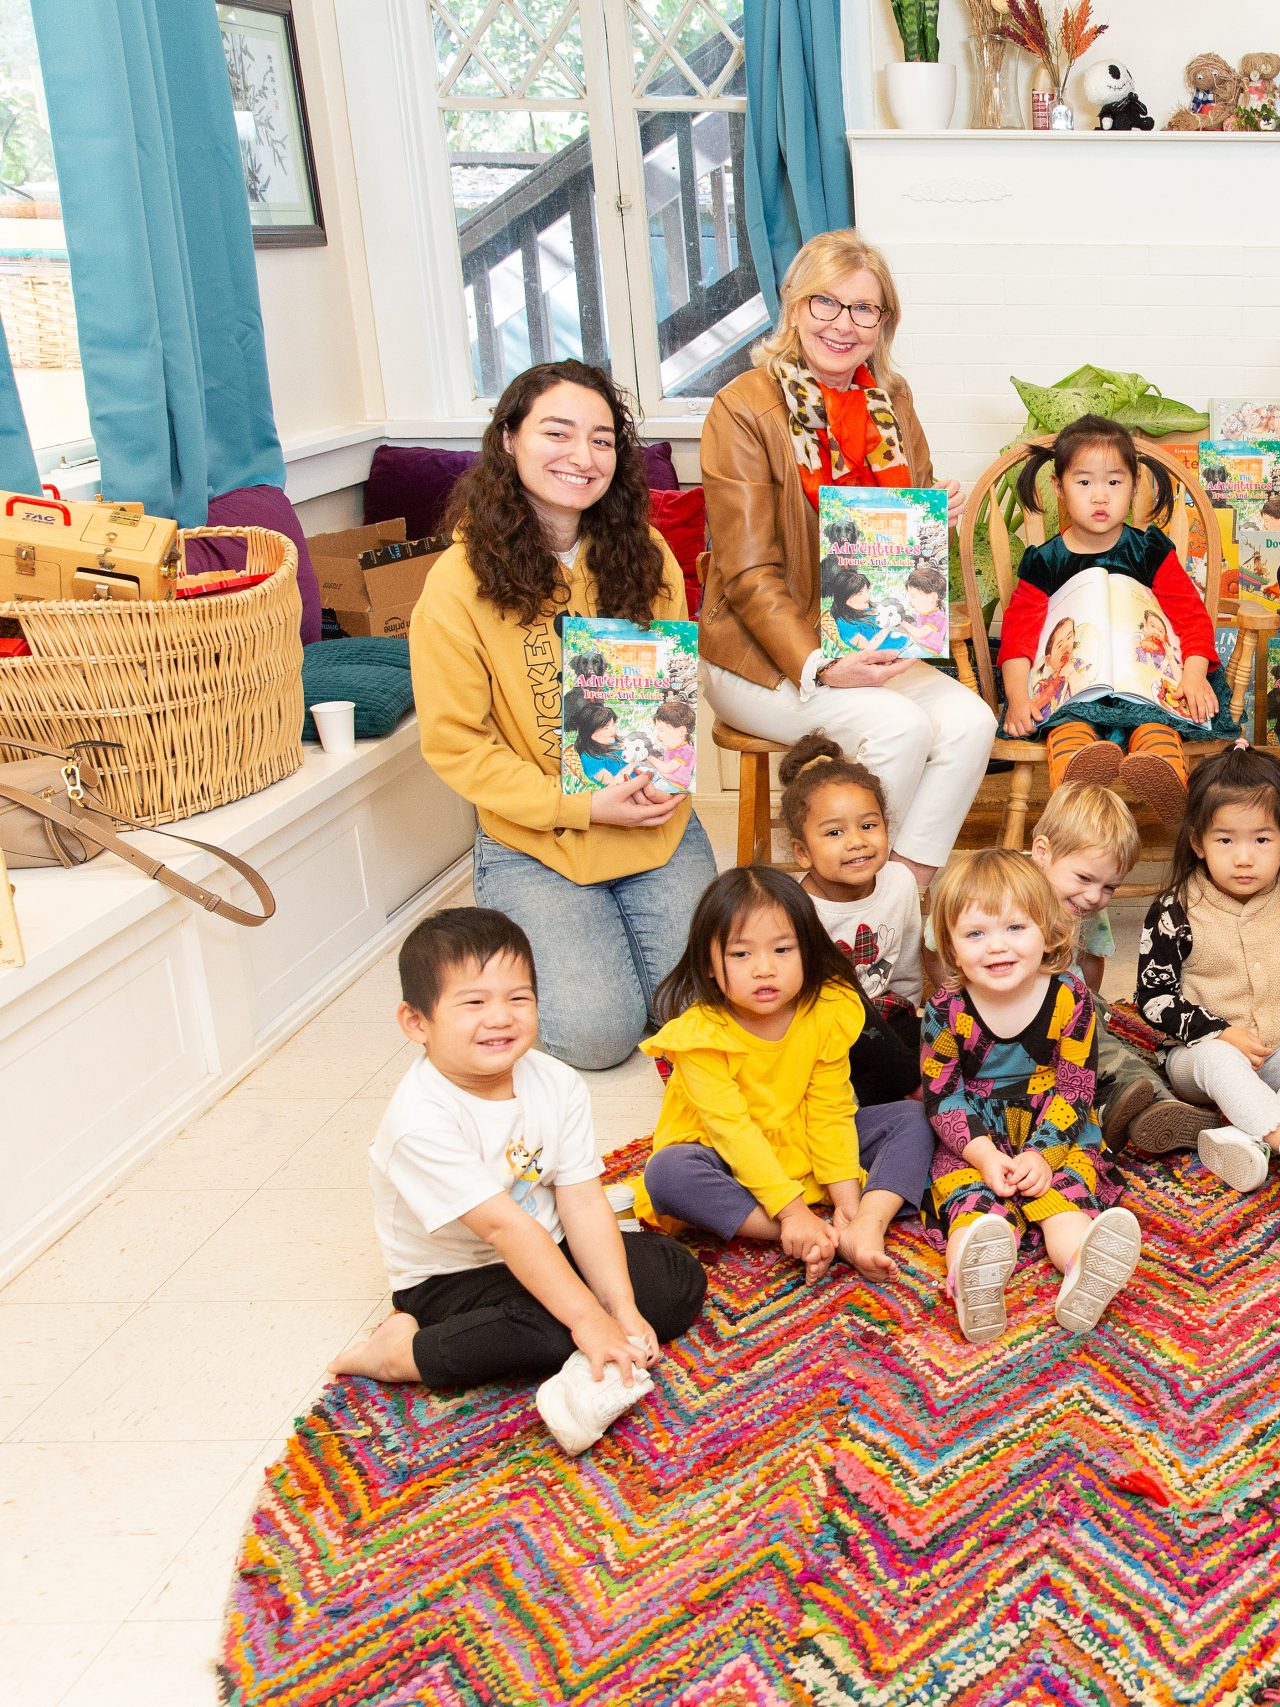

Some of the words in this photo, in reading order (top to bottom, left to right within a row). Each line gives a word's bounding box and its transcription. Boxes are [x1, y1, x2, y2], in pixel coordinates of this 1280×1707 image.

[1207, 480, 1273, 492] Adventures
[828, 542, 921, 556] Adventures
[574, 674, 671, 689] Adventures
